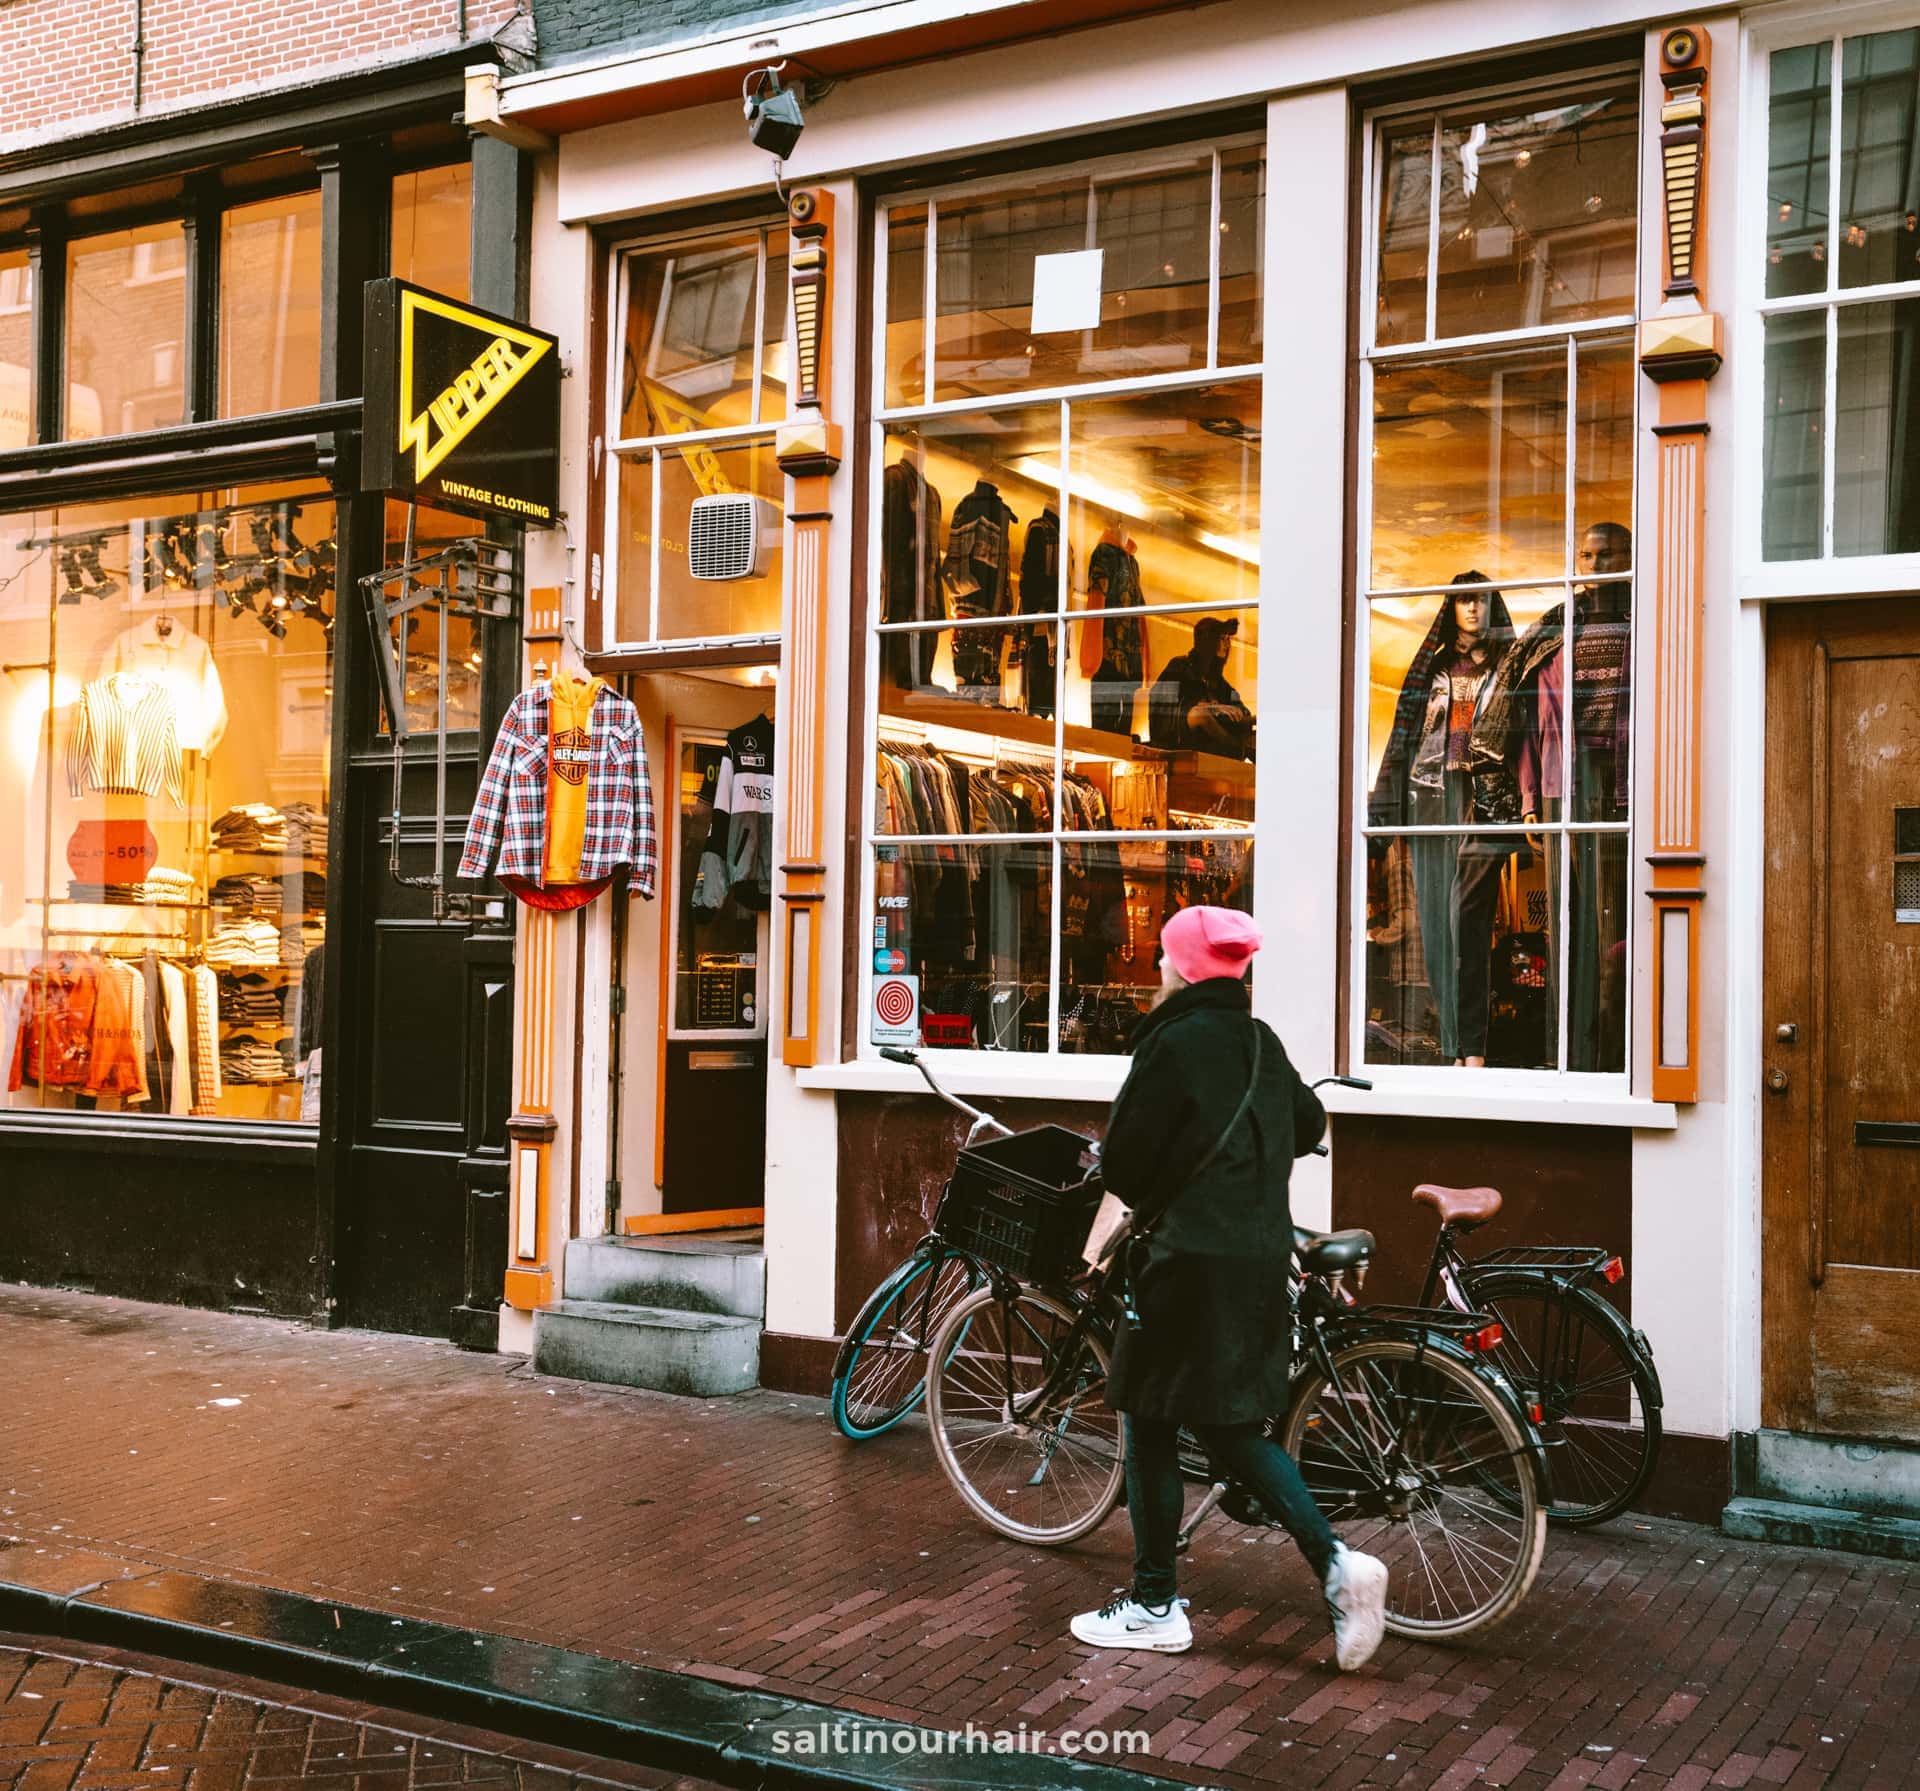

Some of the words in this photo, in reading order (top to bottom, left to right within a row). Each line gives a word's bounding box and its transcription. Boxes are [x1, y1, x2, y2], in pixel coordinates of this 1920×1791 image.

[399, 337, 523, 484] ZIPPER
[440, 479, 492, 504] VINTAGE
[494, 494, 551, 519] CLOTHING
[108, 846, 153, 859] -50%
